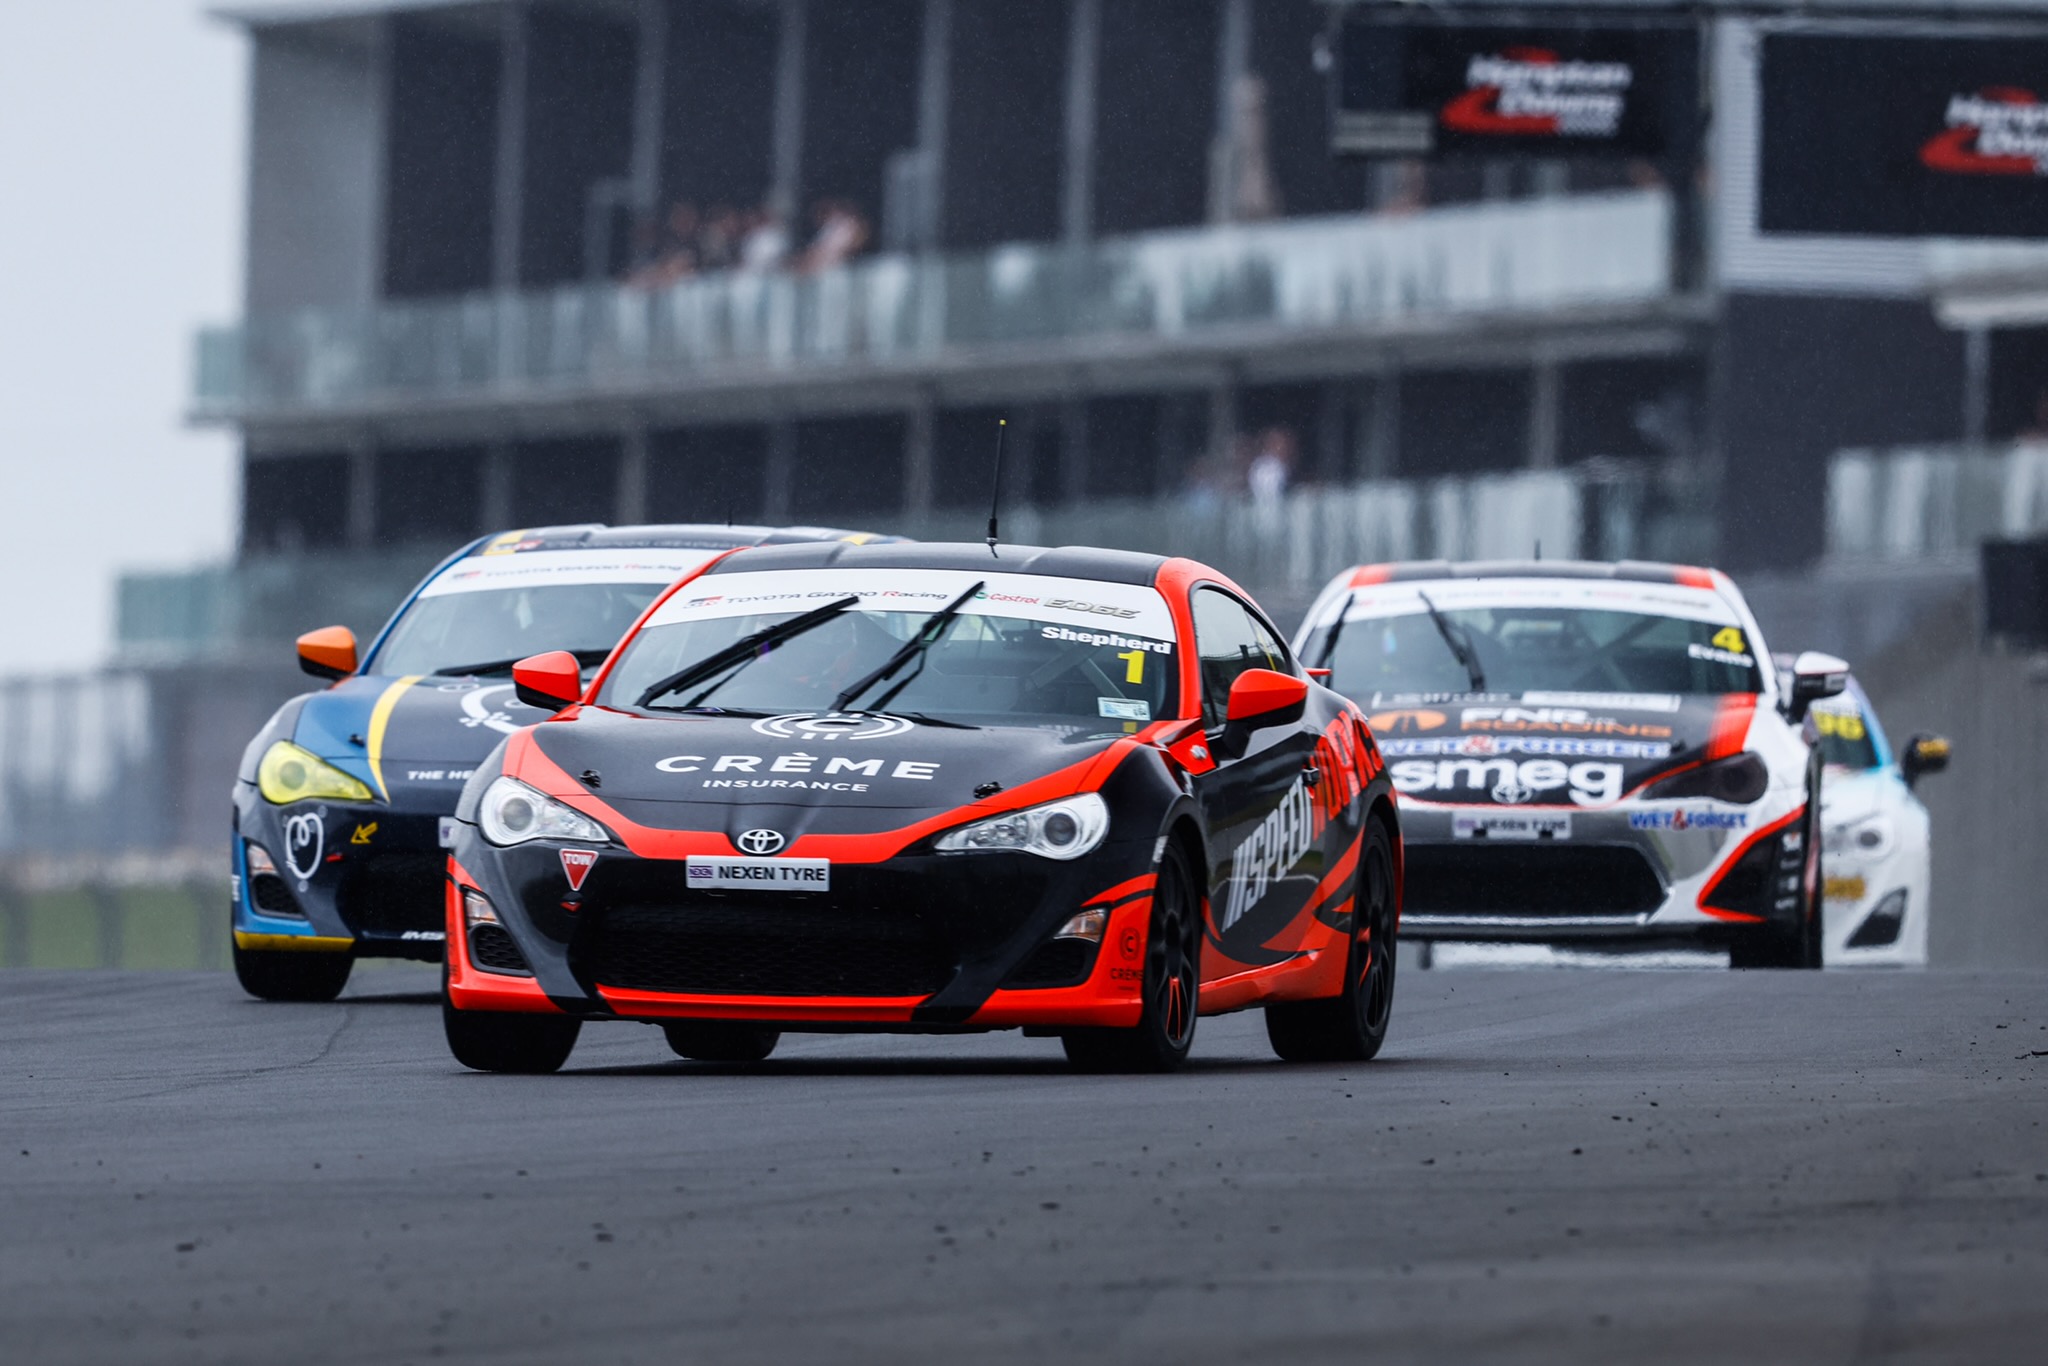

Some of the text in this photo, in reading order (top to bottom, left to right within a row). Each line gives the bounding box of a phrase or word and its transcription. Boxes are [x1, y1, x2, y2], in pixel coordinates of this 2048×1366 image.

[728, 591, 948, 604] TOYOTA GAZOO Racing
[990, 593, 1141, 619] Castrol EDGE
[1041, 626, 1172, 655] Shepherd
[1711, 626, 1745, 654] 4
[1117, 649, 1145, 685] 1
[406, 770, 477, 780] THE HE
[655, 752, 941, 781] CRÈME
[702, 779, 869, 792] INSURANCE
[1391, 758, 1624, 806] smeg
[564, 853, 592, 865] TOW
[718, 866, 826, 881] NEXEN TYRE
